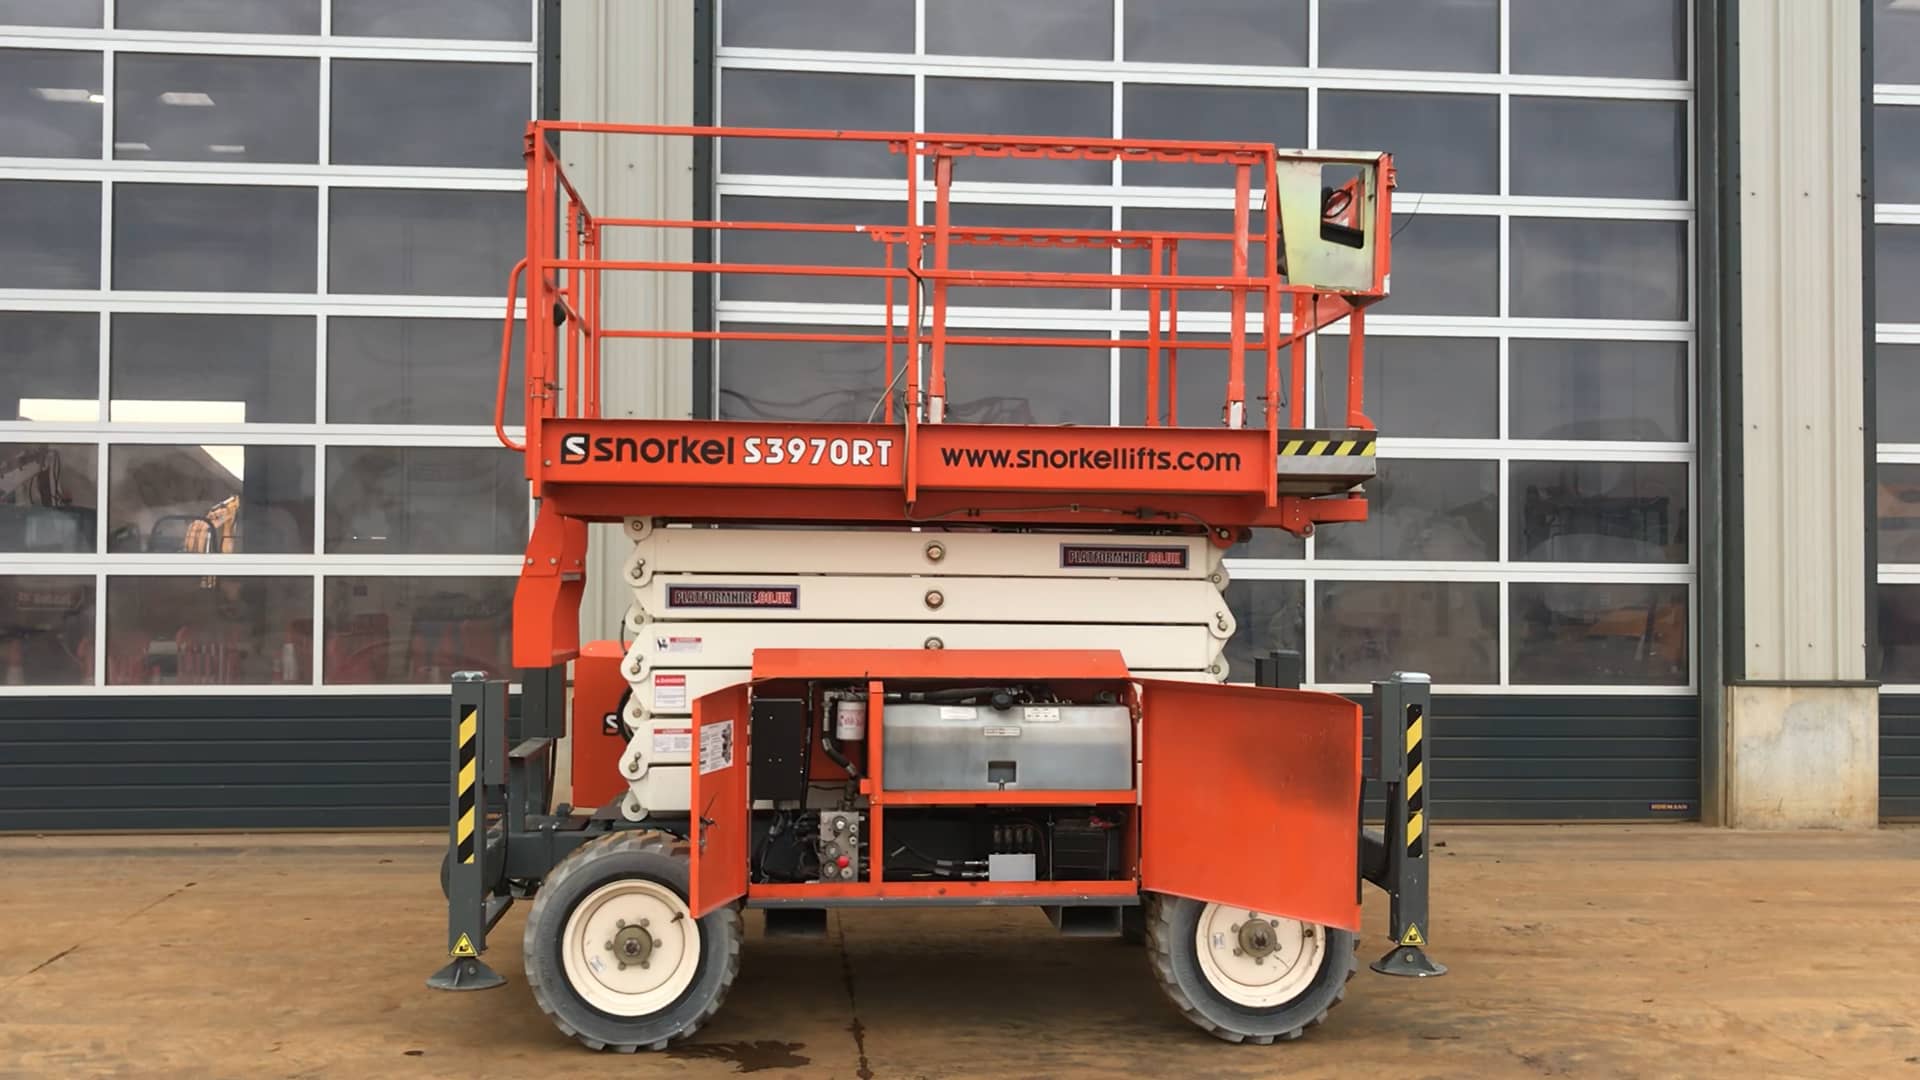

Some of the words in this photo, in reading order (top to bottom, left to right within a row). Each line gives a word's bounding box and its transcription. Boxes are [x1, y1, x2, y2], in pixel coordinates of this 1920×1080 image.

[594, 435, 734, 464] snorkel
[743, 437, 893, 466] S3970RT
[941, 446, 1241, 471] www.snorkellifts.com
